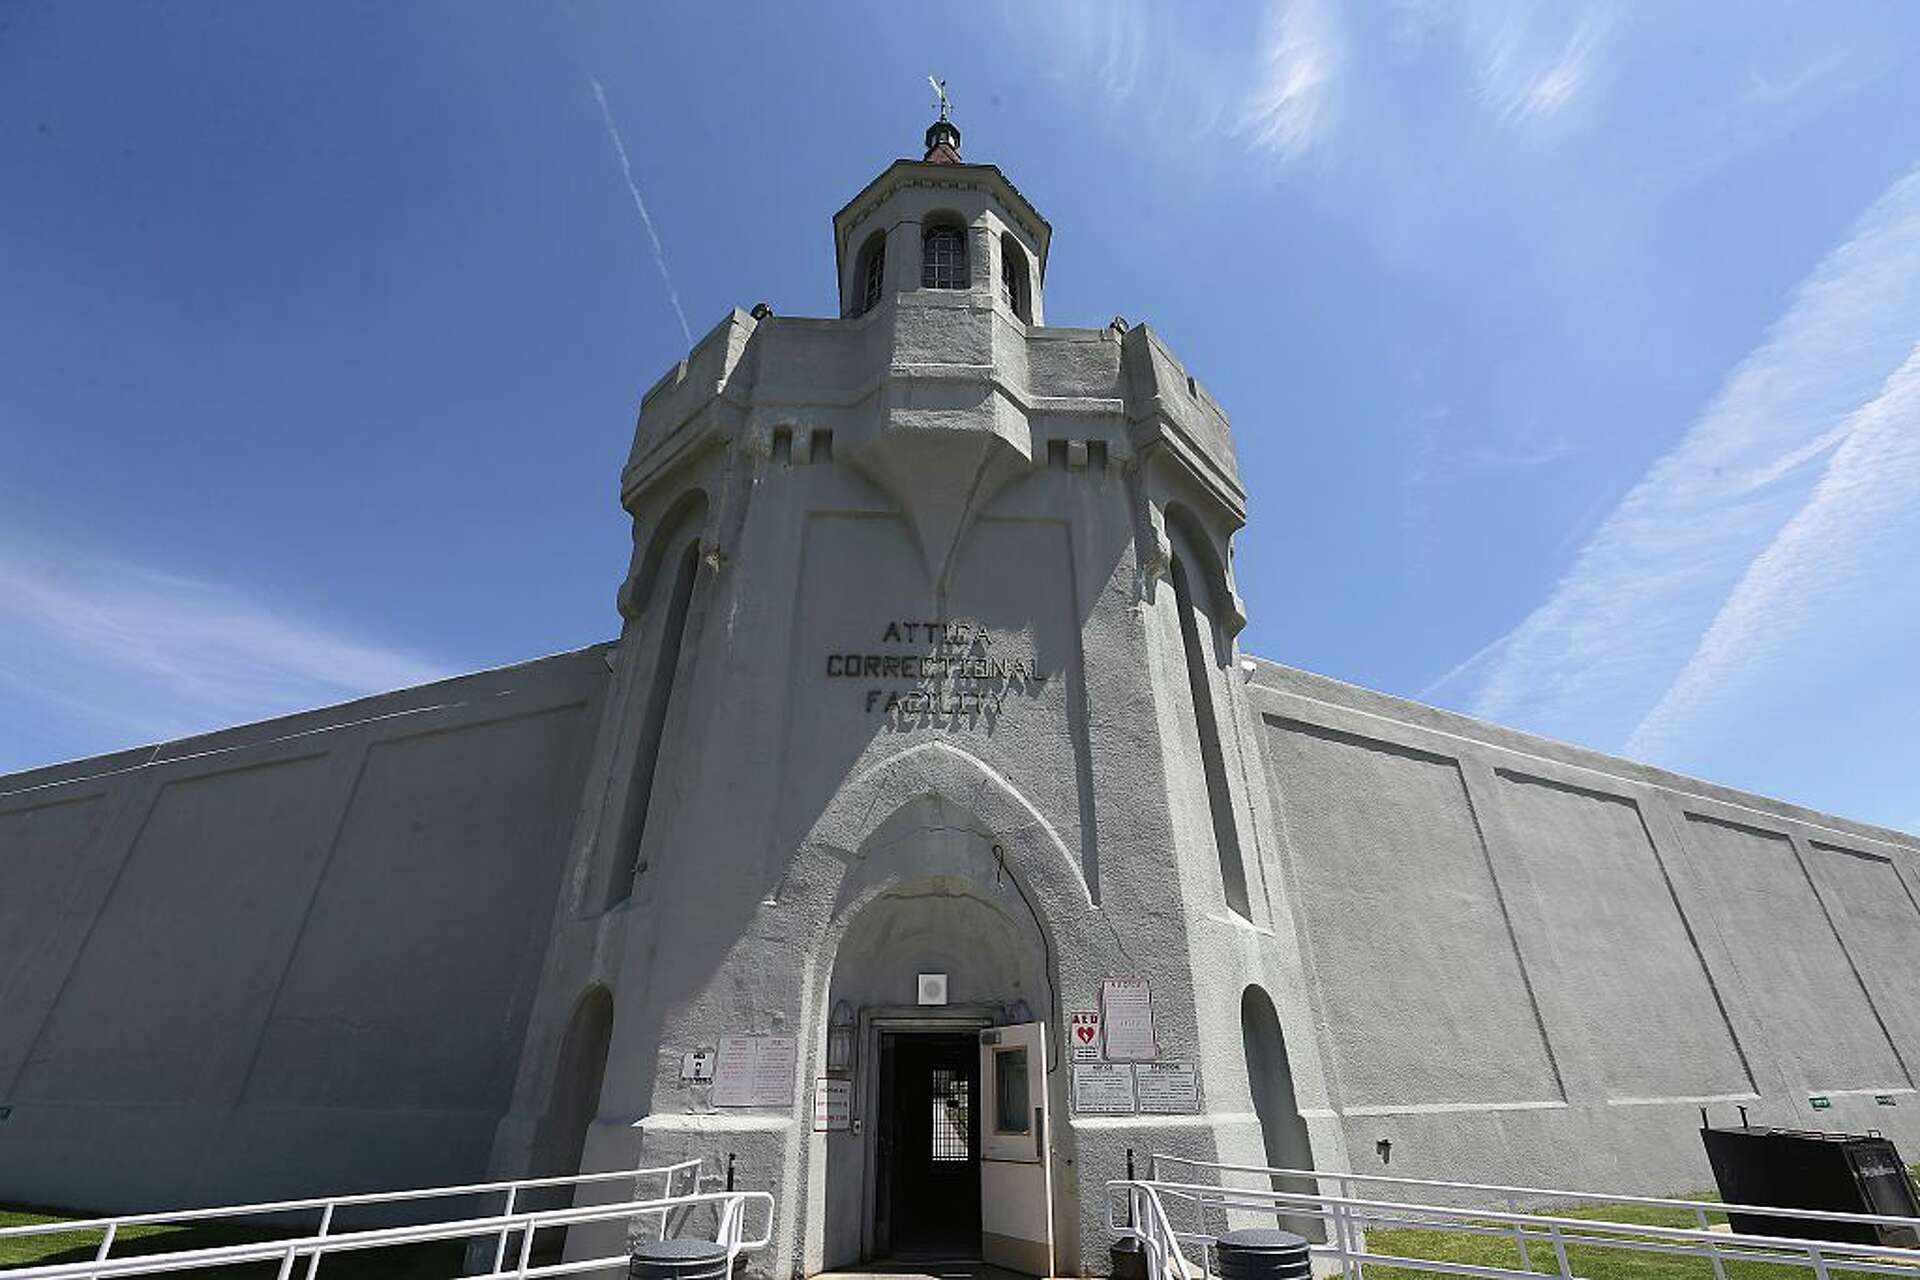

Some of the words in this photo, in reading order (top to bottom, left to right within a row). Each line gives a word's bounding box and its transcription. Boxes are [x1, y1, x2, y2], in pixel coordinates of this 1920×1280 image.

[882, 621, 992, 645] ATTICA
[826, 655, 1046, 680] CORRECTIONAL
[864, 690, 1002, 714] FACILITY
